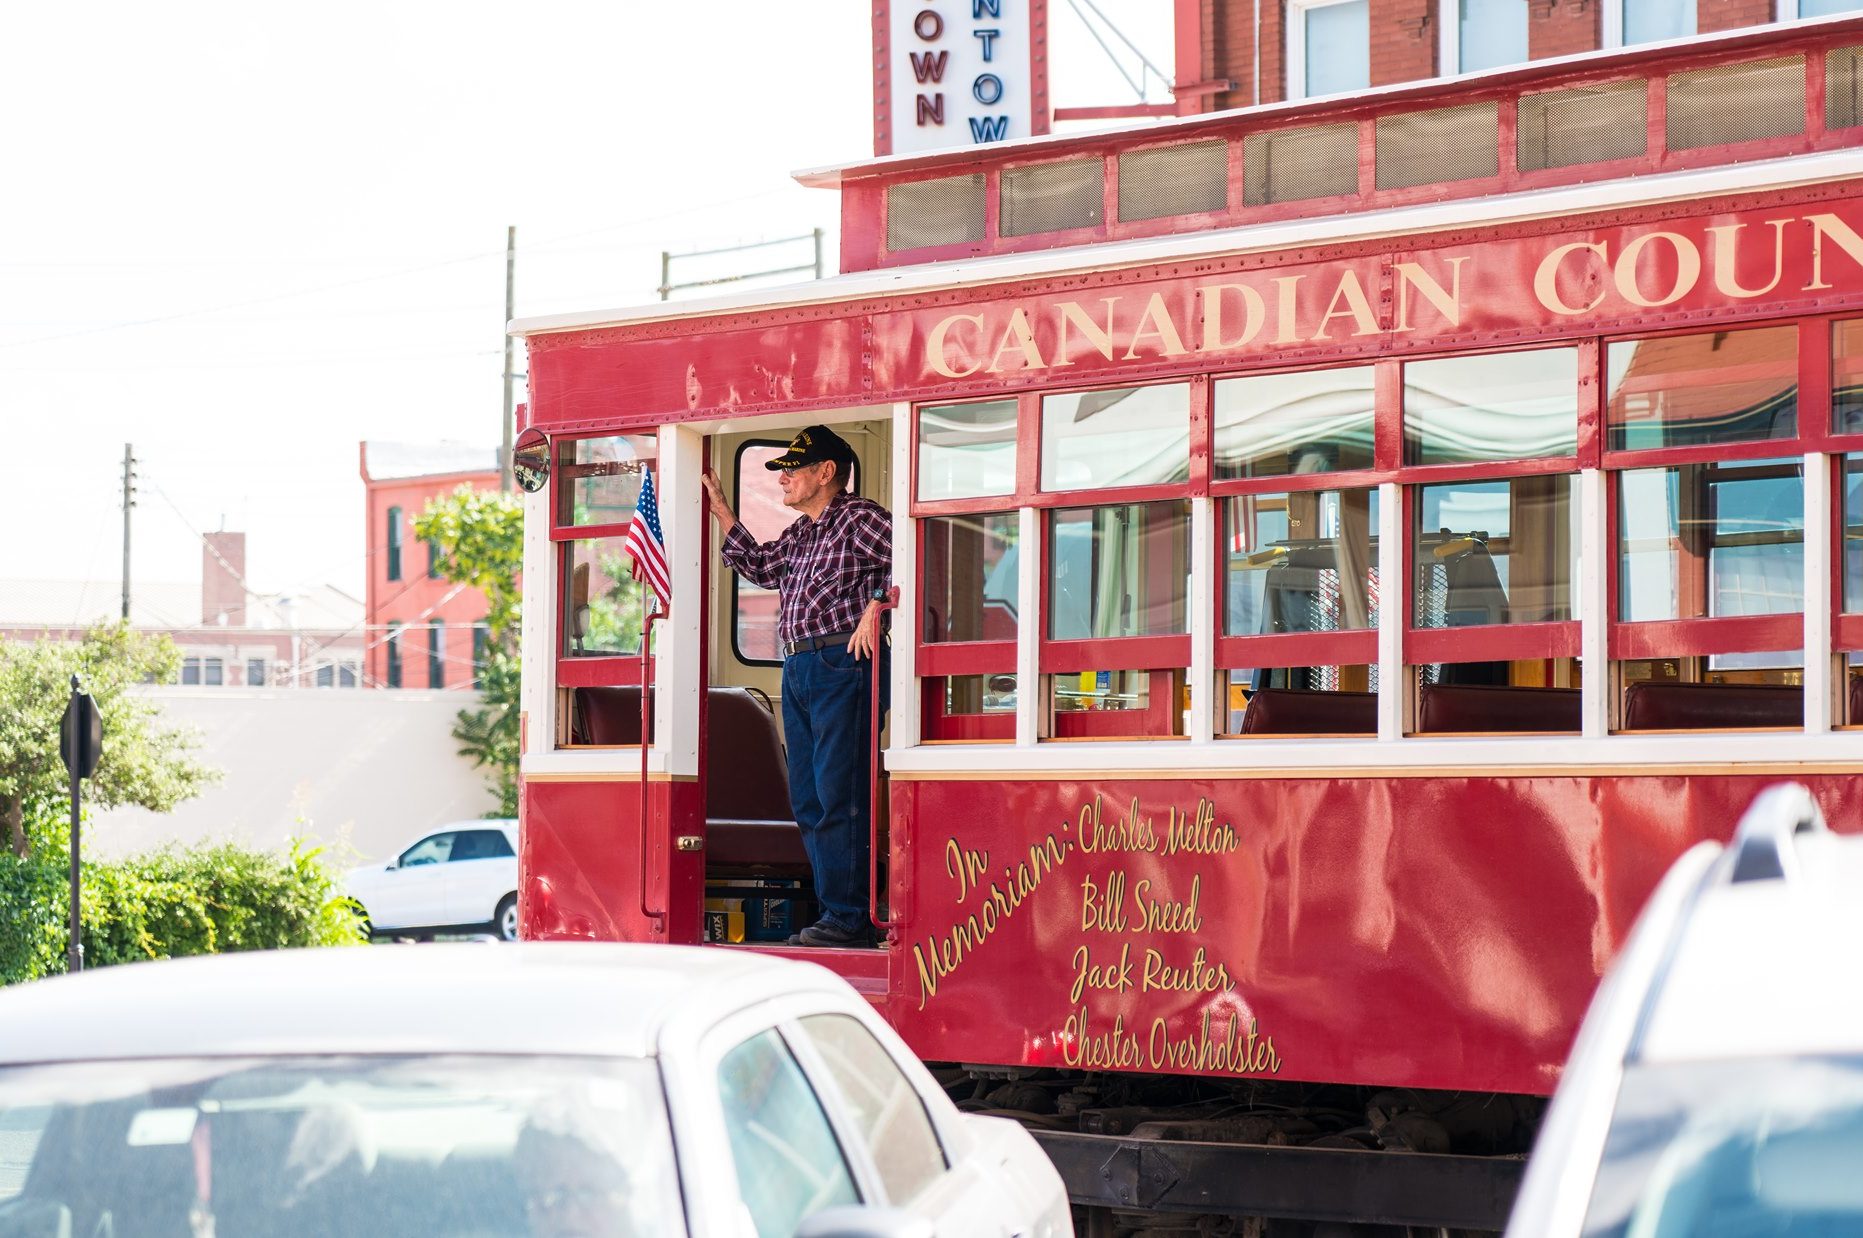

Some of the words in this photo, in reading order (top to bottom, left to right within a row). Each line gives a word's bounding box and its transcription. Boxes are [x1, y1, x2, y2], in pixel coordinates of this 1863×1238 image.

[909, 0, 948, 126] OWN
[968, 0, 1008, 144] NTOW
[926, 256, 1470, 380] CANADIAN
[1533, 212, 1863, 318] COUN
[1078, 794, 1159, 854] Charles
[1161, 797, 1240, 856] Melton
[946, 838, 989, 904] In
[1081, 870, 1127, 934] Bill
[1131, 874, 1202, 935] Sneed
[713, 915, 722, 940] WIX
[913, 822, 1075, 1012] Memoriam:
[1071, 943, 1134, 1005] Jack
[1142, 947, 1236, 994] Reuter
[1062, 1005, 1145, 1069] Chester
[1149, 1009, 1283, 1075] Overholster
